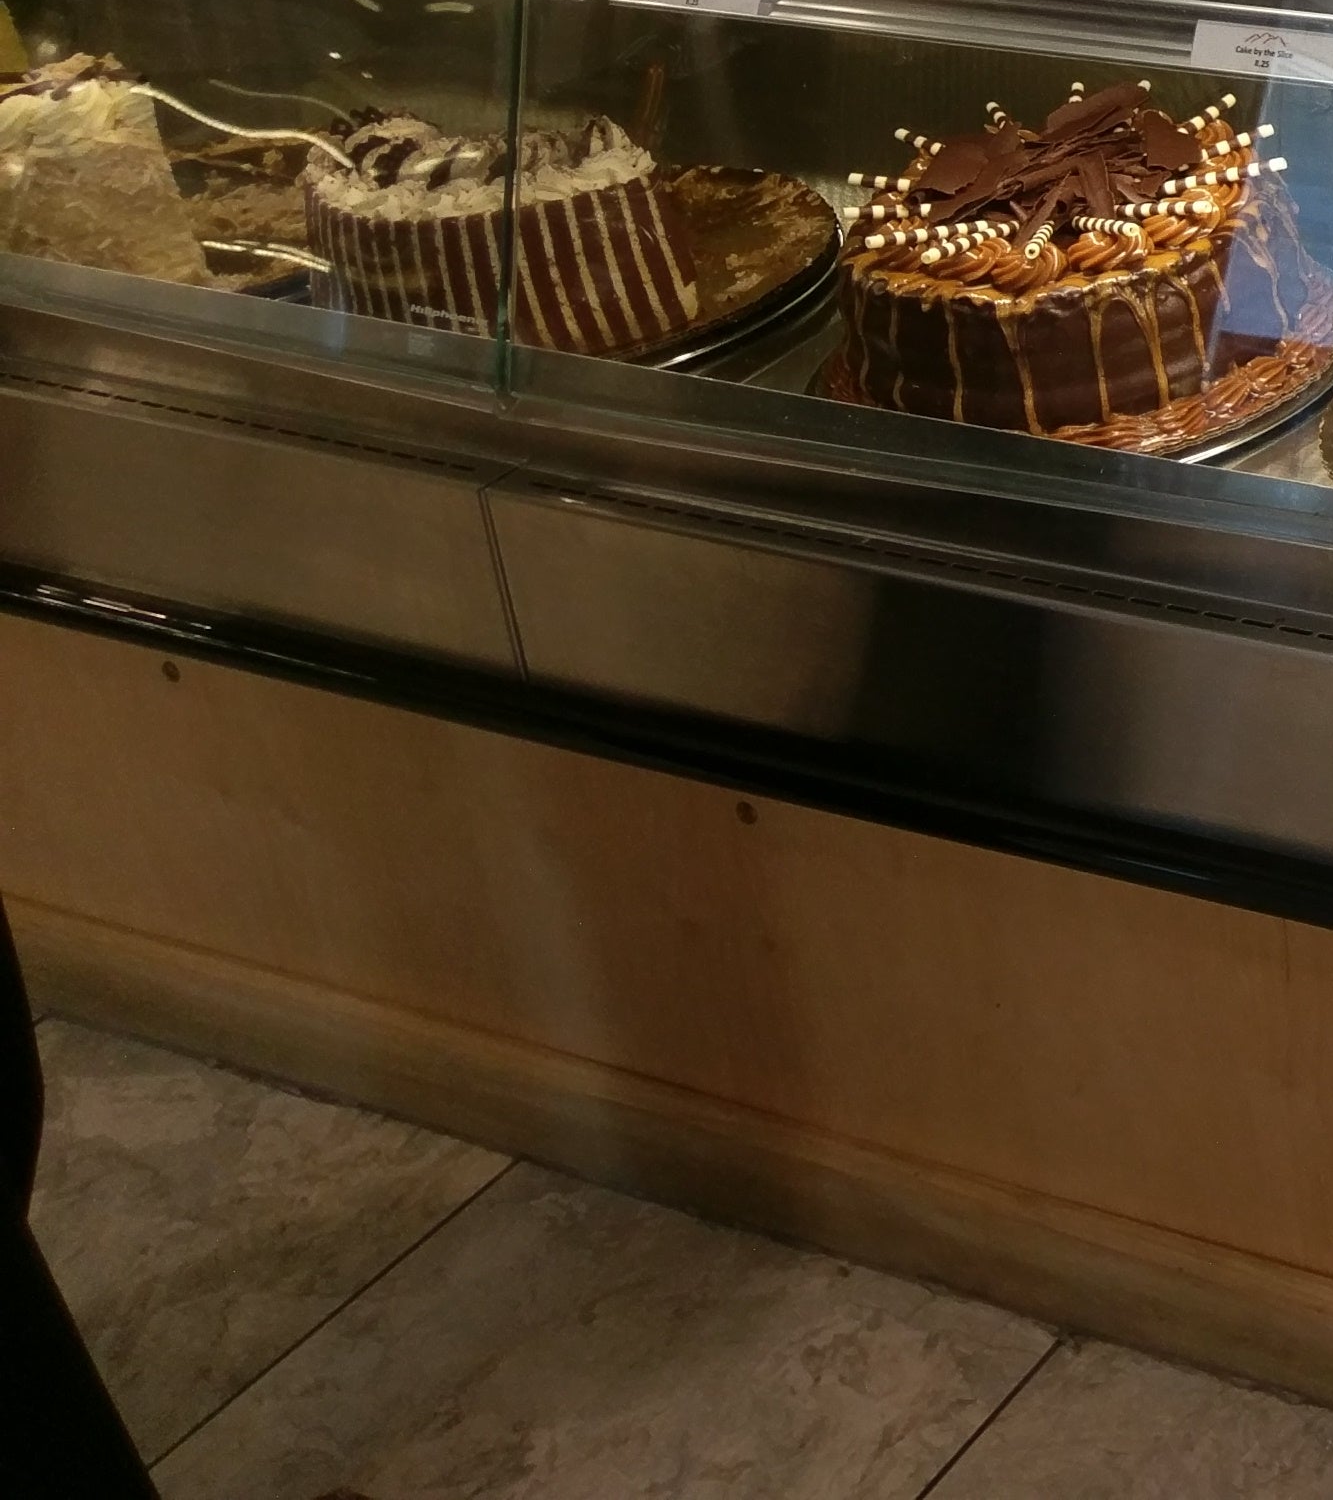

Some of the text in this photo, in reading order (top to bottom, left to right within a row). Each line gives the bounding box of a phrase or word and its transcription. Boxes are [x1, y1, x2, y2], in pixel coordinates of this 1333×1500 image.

[1235, 46, 1253, 54] Cake
[1254, 48, 1262, 56] by
[1264, 49, 1275, 57] the
[410, 304, 488, 327] Hillphoen
